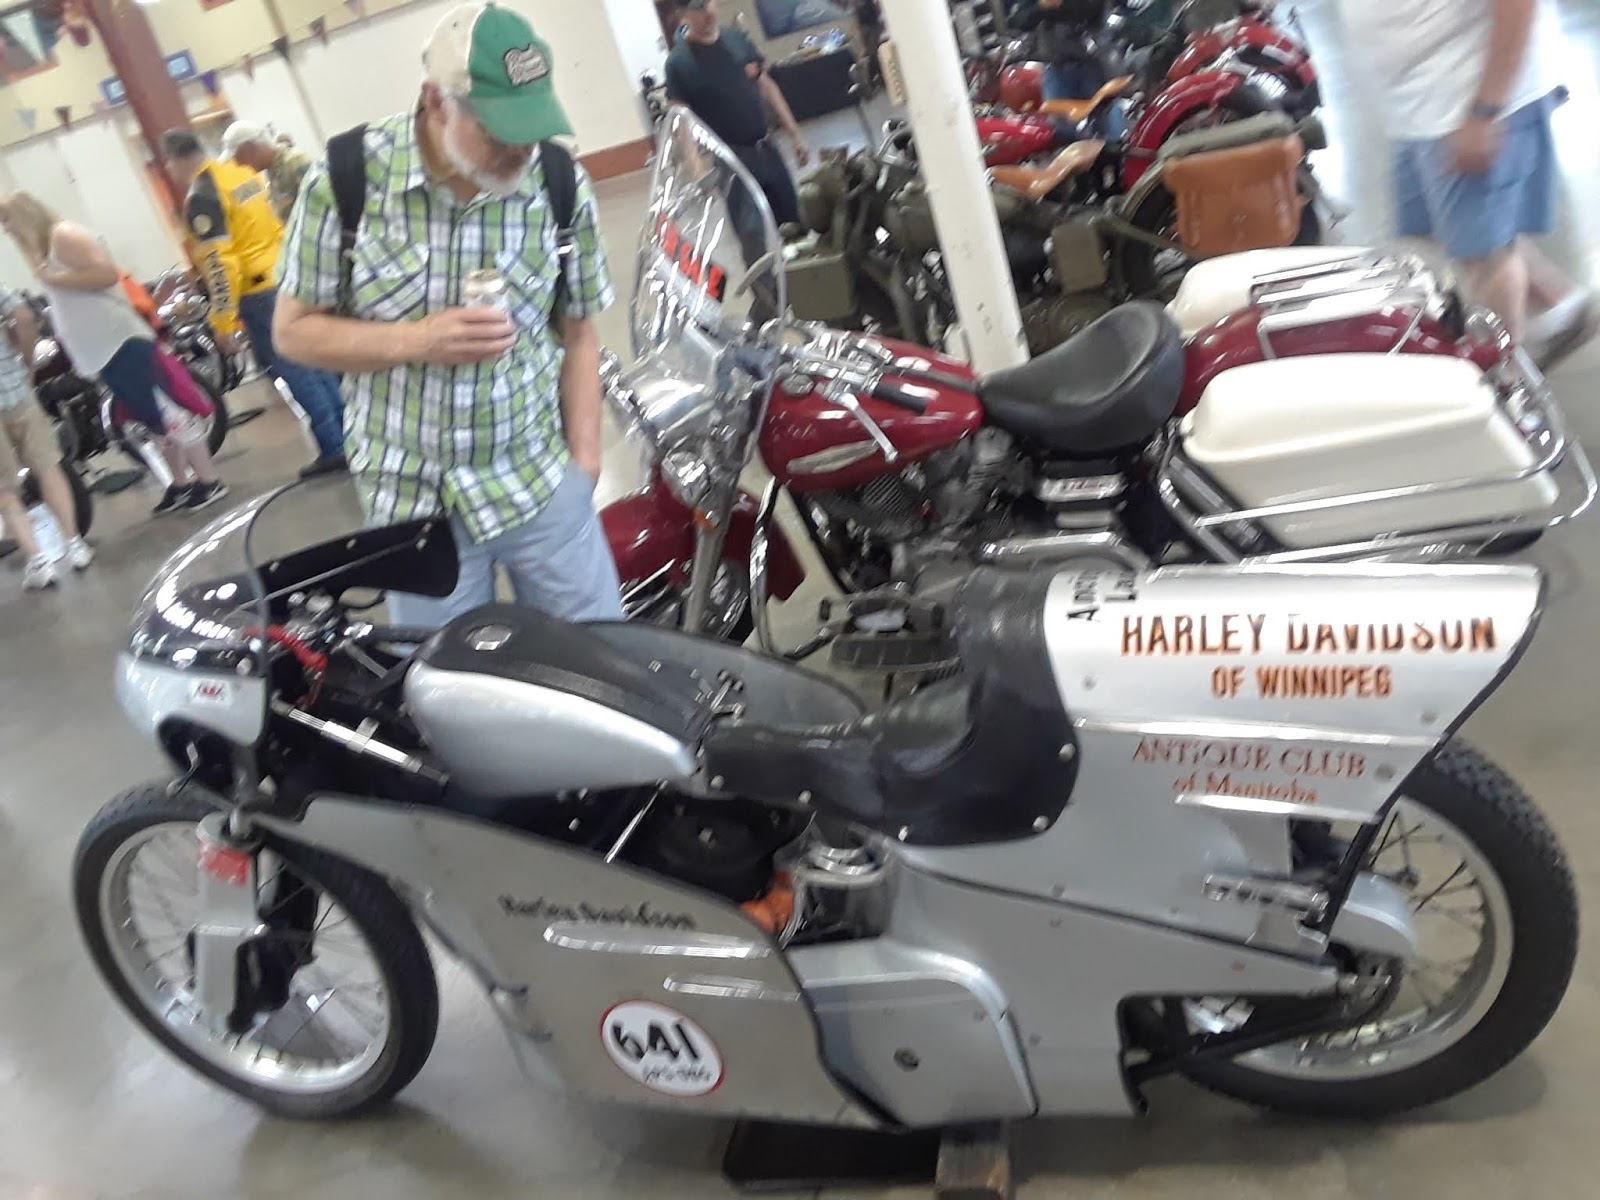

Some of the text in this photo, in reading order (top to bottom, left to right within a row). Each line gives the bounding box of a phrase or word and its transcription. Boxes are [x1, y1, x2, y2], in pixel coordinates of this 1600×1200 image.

[1121, 614, 1497, 656] HARLEY DAVIDSON
[1211, 664, 1393, 699] OF WINNIPEG
[1132, 736, 1368, 779] ANTIQUE CLUB
